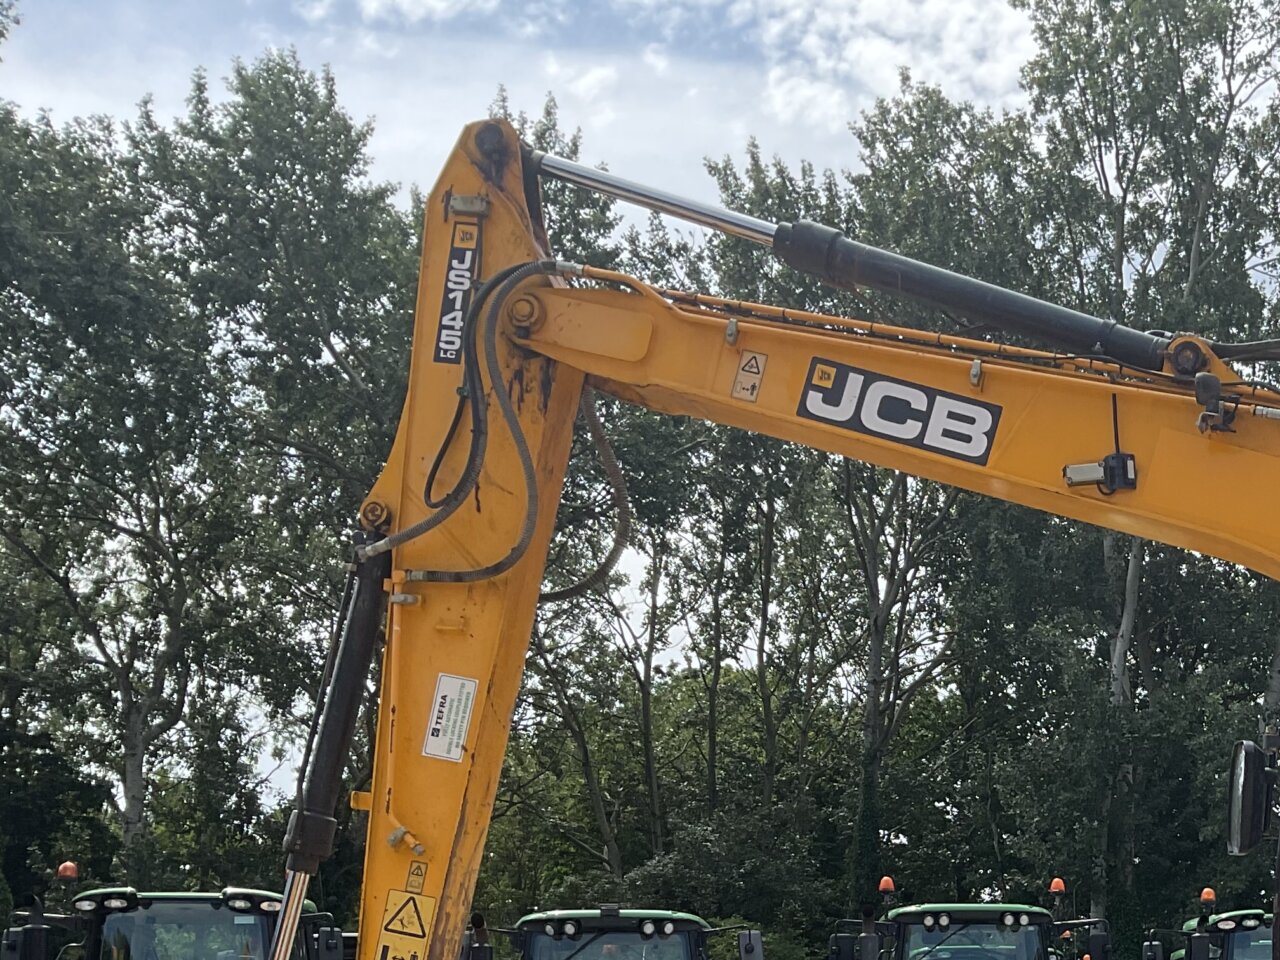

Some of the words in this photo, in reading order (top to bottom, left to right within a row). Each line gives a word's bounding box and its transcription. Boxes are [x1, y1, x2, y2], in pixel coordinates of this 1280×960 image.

[439, 250, 472, 350] JS145
[440, 350, 456, 358] LC
[806, 372, 993, 457] JCB
[435, 694, 448, 726] TEFRA
